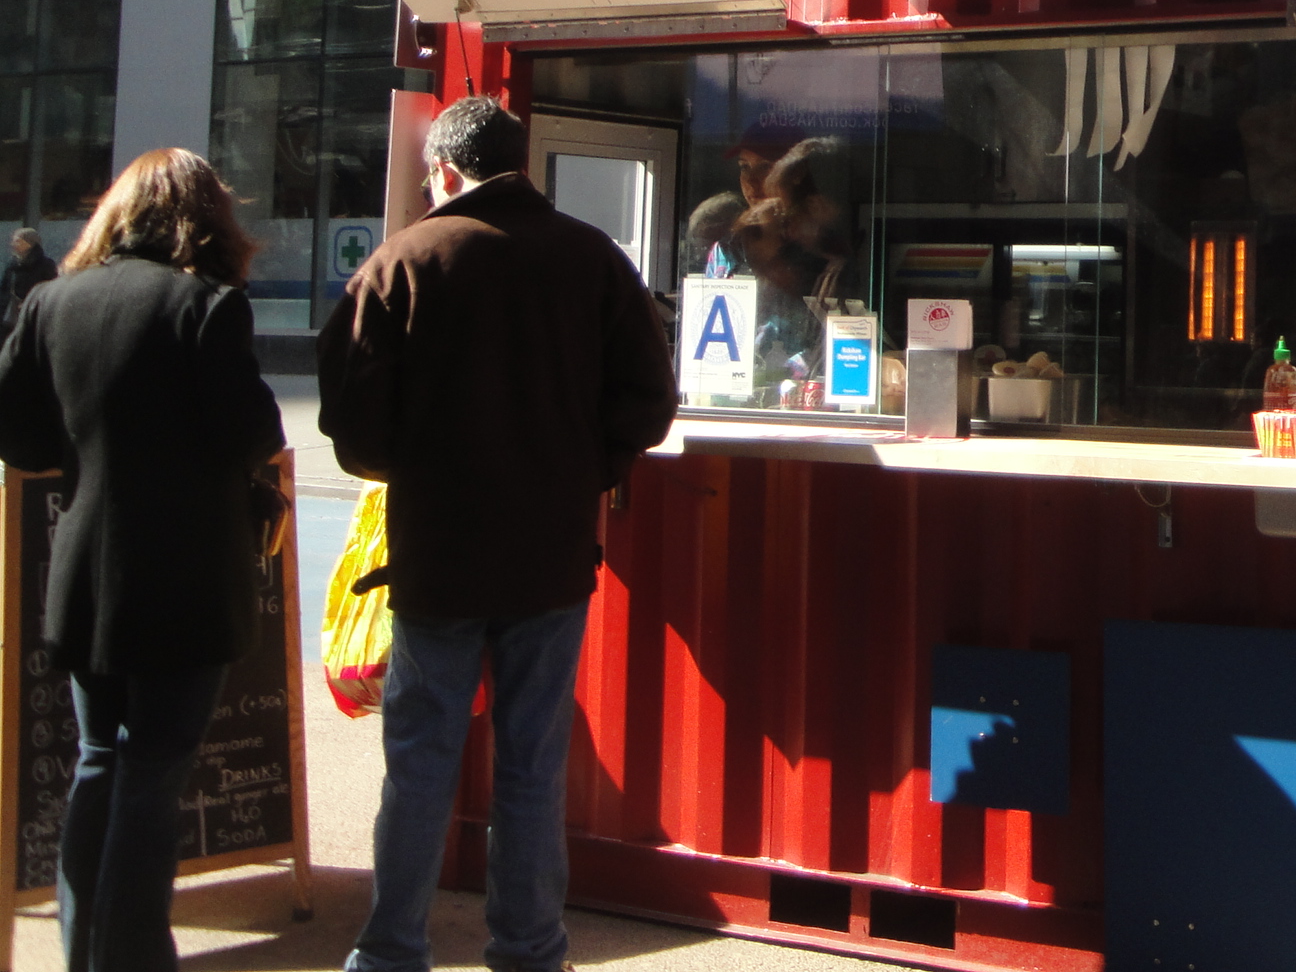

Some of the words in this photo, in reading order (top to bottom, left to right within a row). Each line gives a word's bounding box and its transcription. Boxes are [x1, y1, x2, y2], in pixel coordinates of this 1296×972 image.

[922, 301, 954, 321] RICKSHAW
[693, 294, 741, 362] A
[221, 762, 282, 785] DRINKS
[216, 825, 267, 847] SODA
